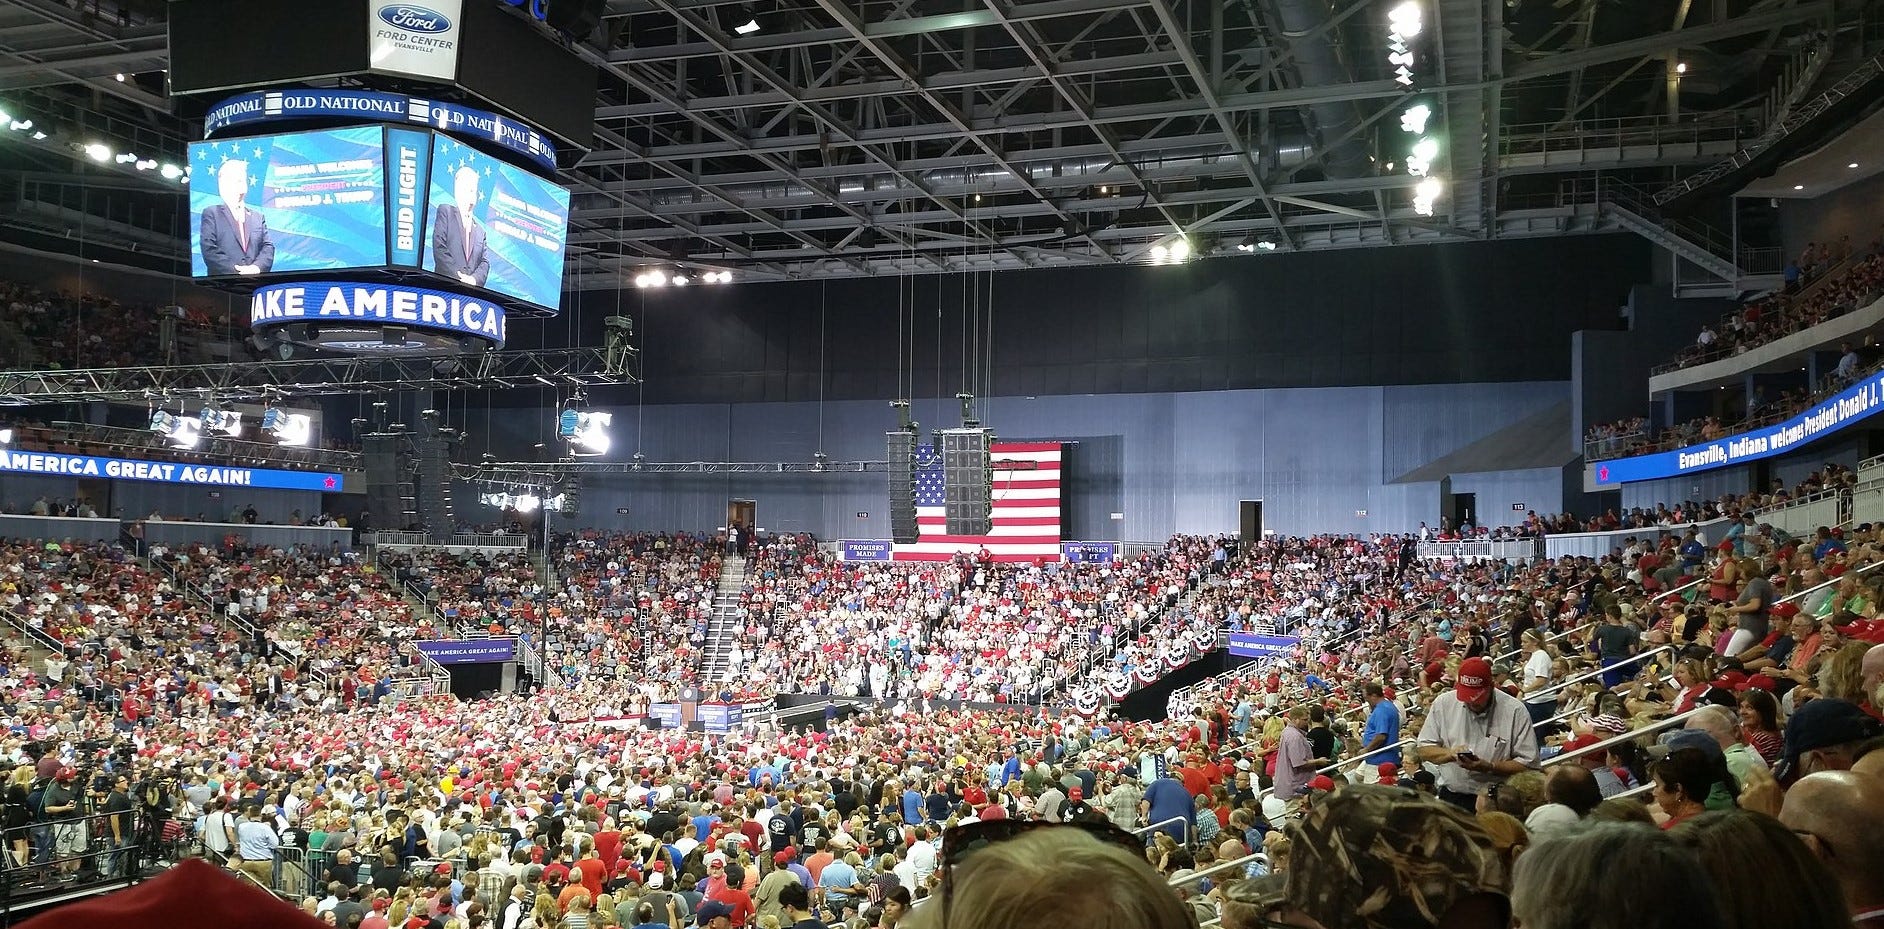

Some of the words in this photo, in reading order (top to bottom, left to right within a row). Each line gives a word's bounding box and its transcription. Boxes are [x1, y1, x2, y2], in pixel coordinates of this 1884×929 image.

[392, 7, 436, 30] Ford
[376, 29, 407, 42] FORD
[410, 35, 453, 50] CENTER
[394, 42, 434, 54] EVANSVILLE
[215, 99, 262, 121] NATIONAL
[284, 96, 316, 109] OLD
[319, 97, 404, 114] NATIONAL
[432, 107, 465, 124] OLD
[467, 115, 528, 145] NATIONAL
[540, 142, 552, 159] OLD
[399, 146, 416, 206] LIGHT
[397, 207, 414, 251] BUD
[319, 286, 498, 336] AMERICA
[1679, 444, 1728, 470] Evansville,
[1729, 436, 1768, 459] Indiana
[1770, 422, 1805, 450] welcomes
[1804, 402, 1838, 437] President
[1839, 385, 1868, 422] Donald
[1869, 382, 1879, 408] J.
[0, 450, 99, 475] AMERICA
[105, 460, 175, 481] GREAT
[180, 466, 251, 485] AGAIN!
